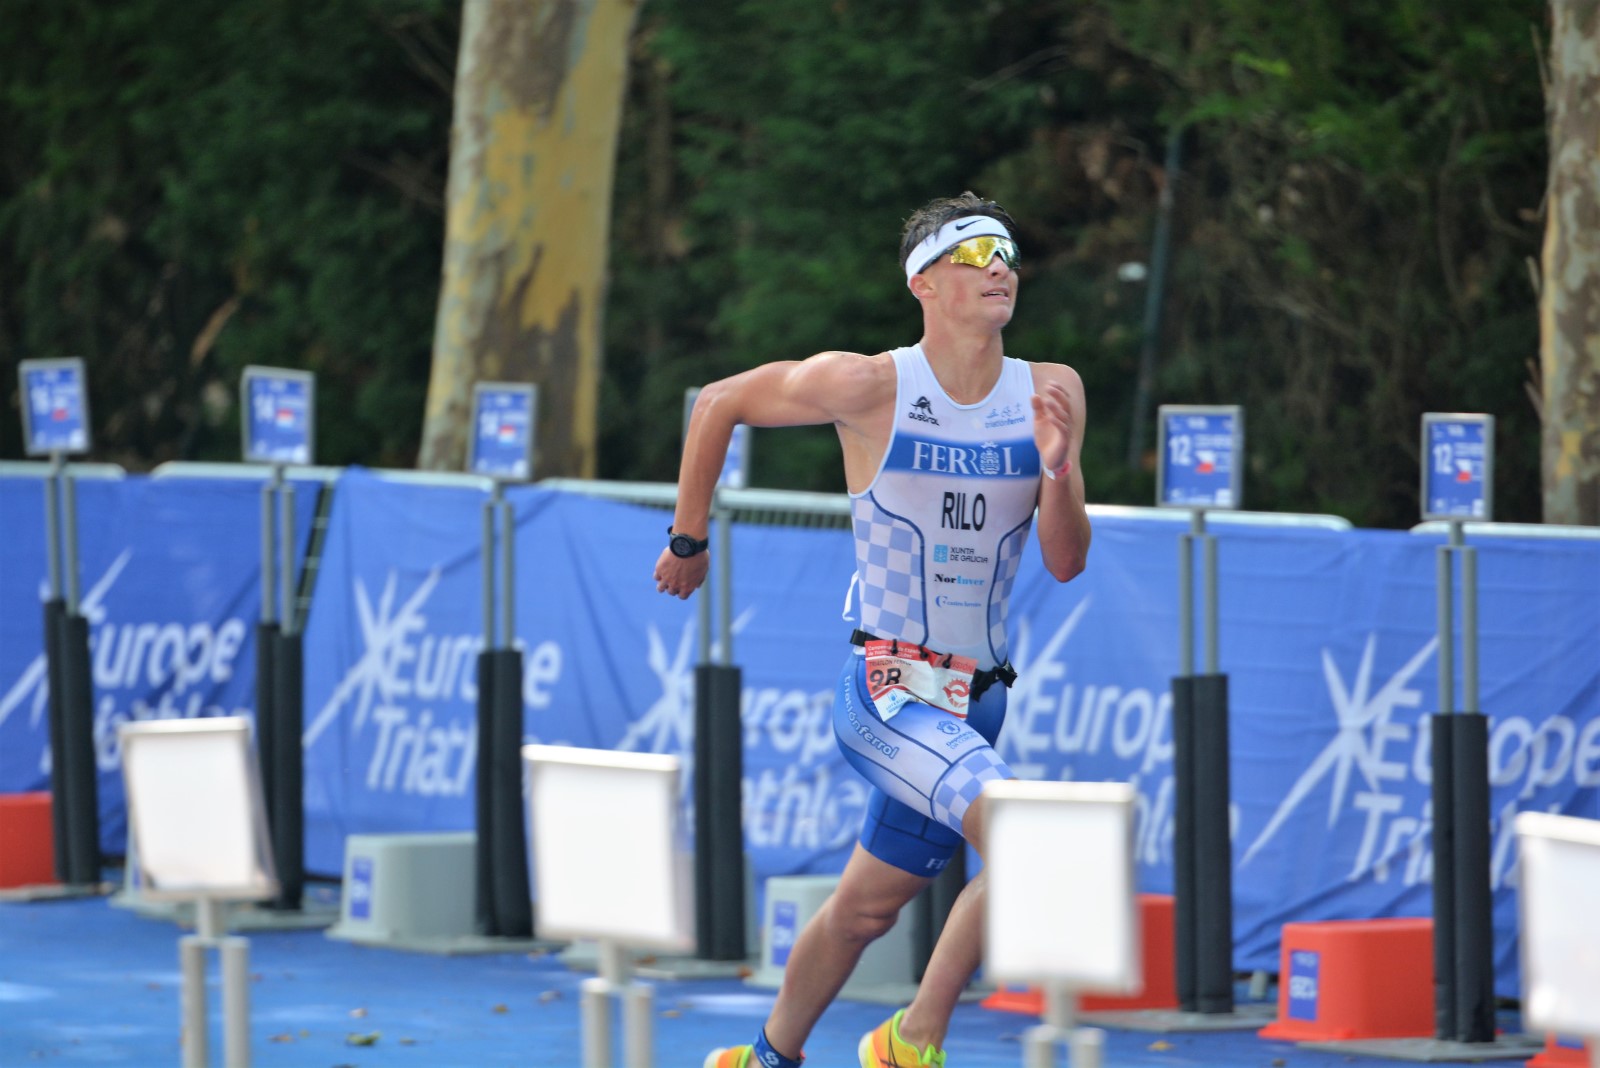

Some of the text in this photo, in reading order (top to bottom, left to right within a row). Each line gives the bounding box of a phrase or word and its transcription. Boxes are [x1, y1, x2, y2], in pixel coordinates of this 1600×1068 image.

[911, 440, 1022, 476] FERRL
[1169, 434, 1191, 466] 12
[1433, 443, 1453, 474] 12
[941, 491, 986, 532] RILO
[950, 547, 975, 555] XUNTA
[961, 555, 988, 564] GALICIA
[88, 604, 246, 695] urope
[386, 610, 562, 708] Eure
[1024, 661, 1175, 775] Europ
